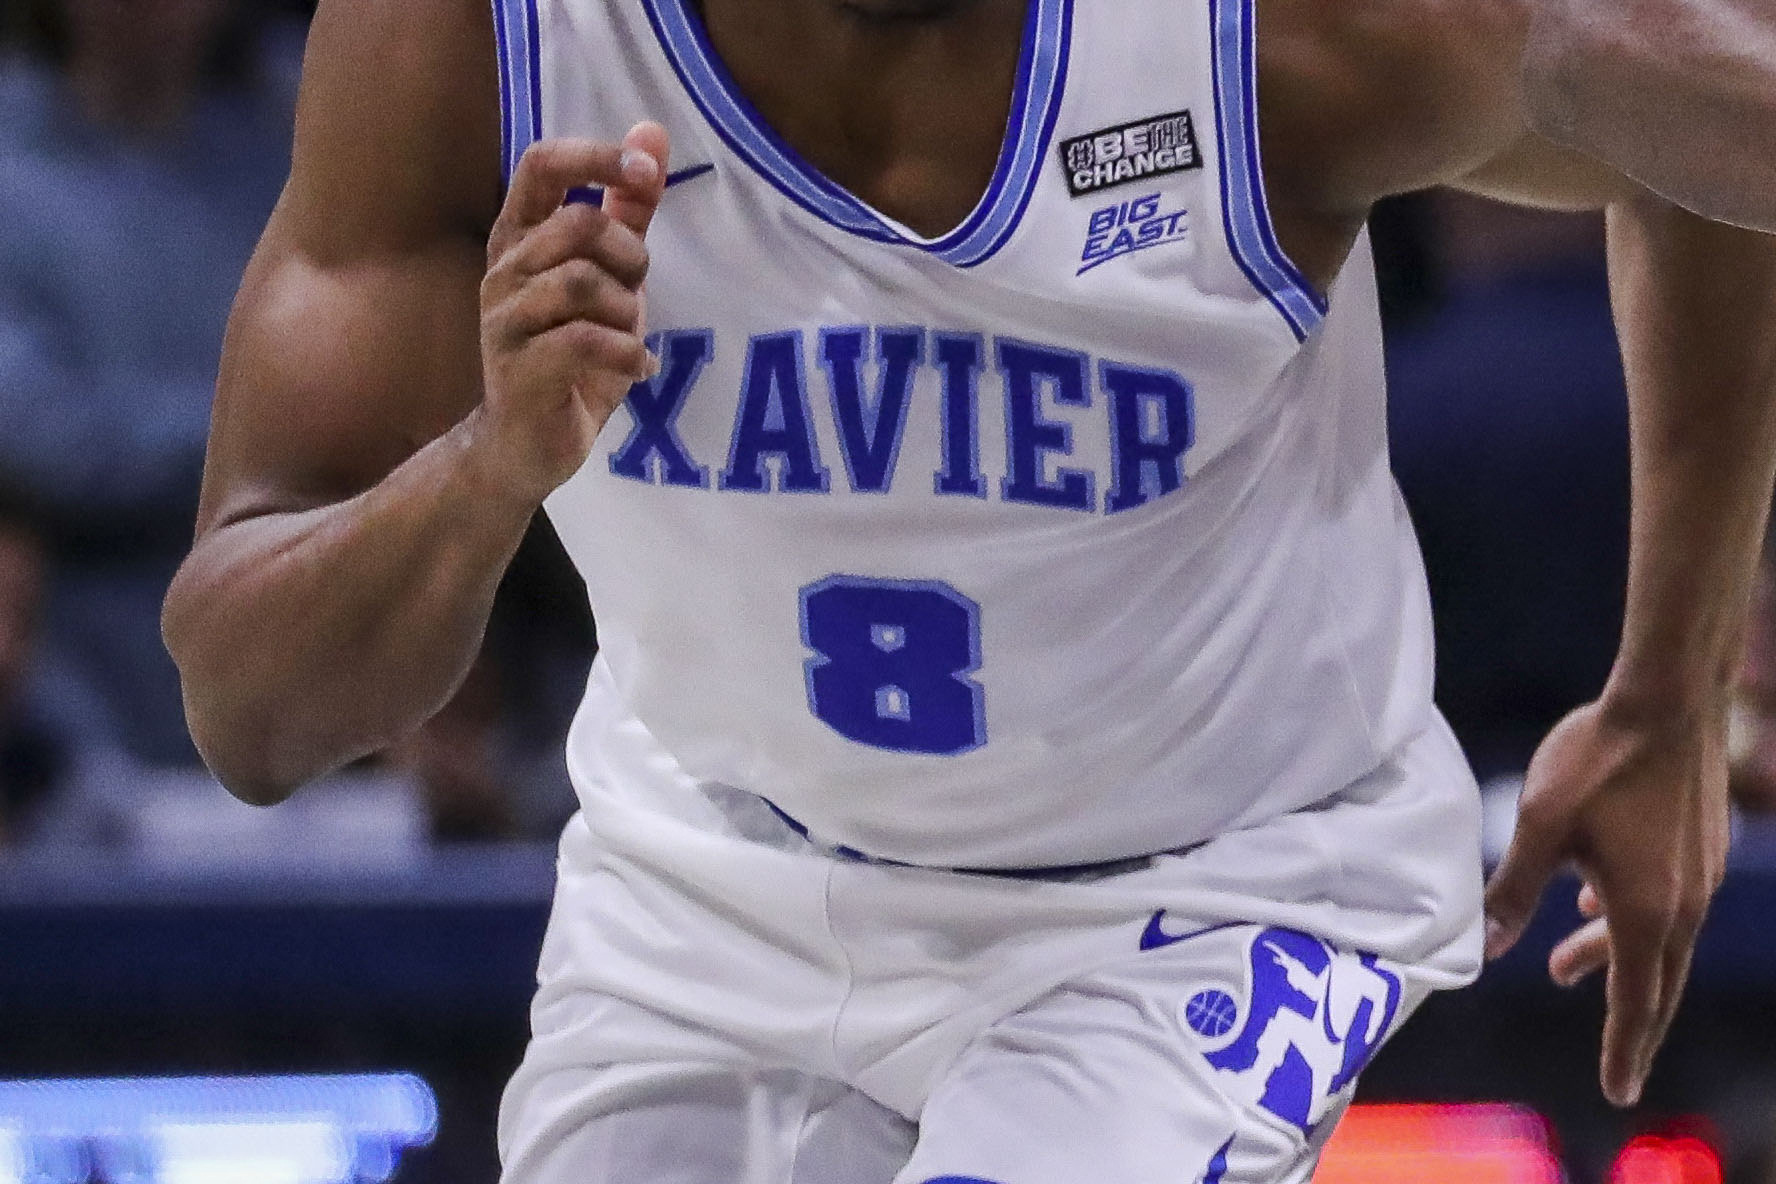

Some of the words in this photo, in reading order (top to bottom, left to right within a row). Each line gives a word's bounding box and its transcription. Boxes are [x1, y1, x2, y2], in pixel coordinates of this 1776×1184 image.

[1072, 143, 1194, 190] CHANGE
[1081, 209, 1188, 261] EAST
[1088, 191, 1162, 236] BIG
[608, 324, 1196, 515] XAVIER
[799, 572, 987, 756] 8
